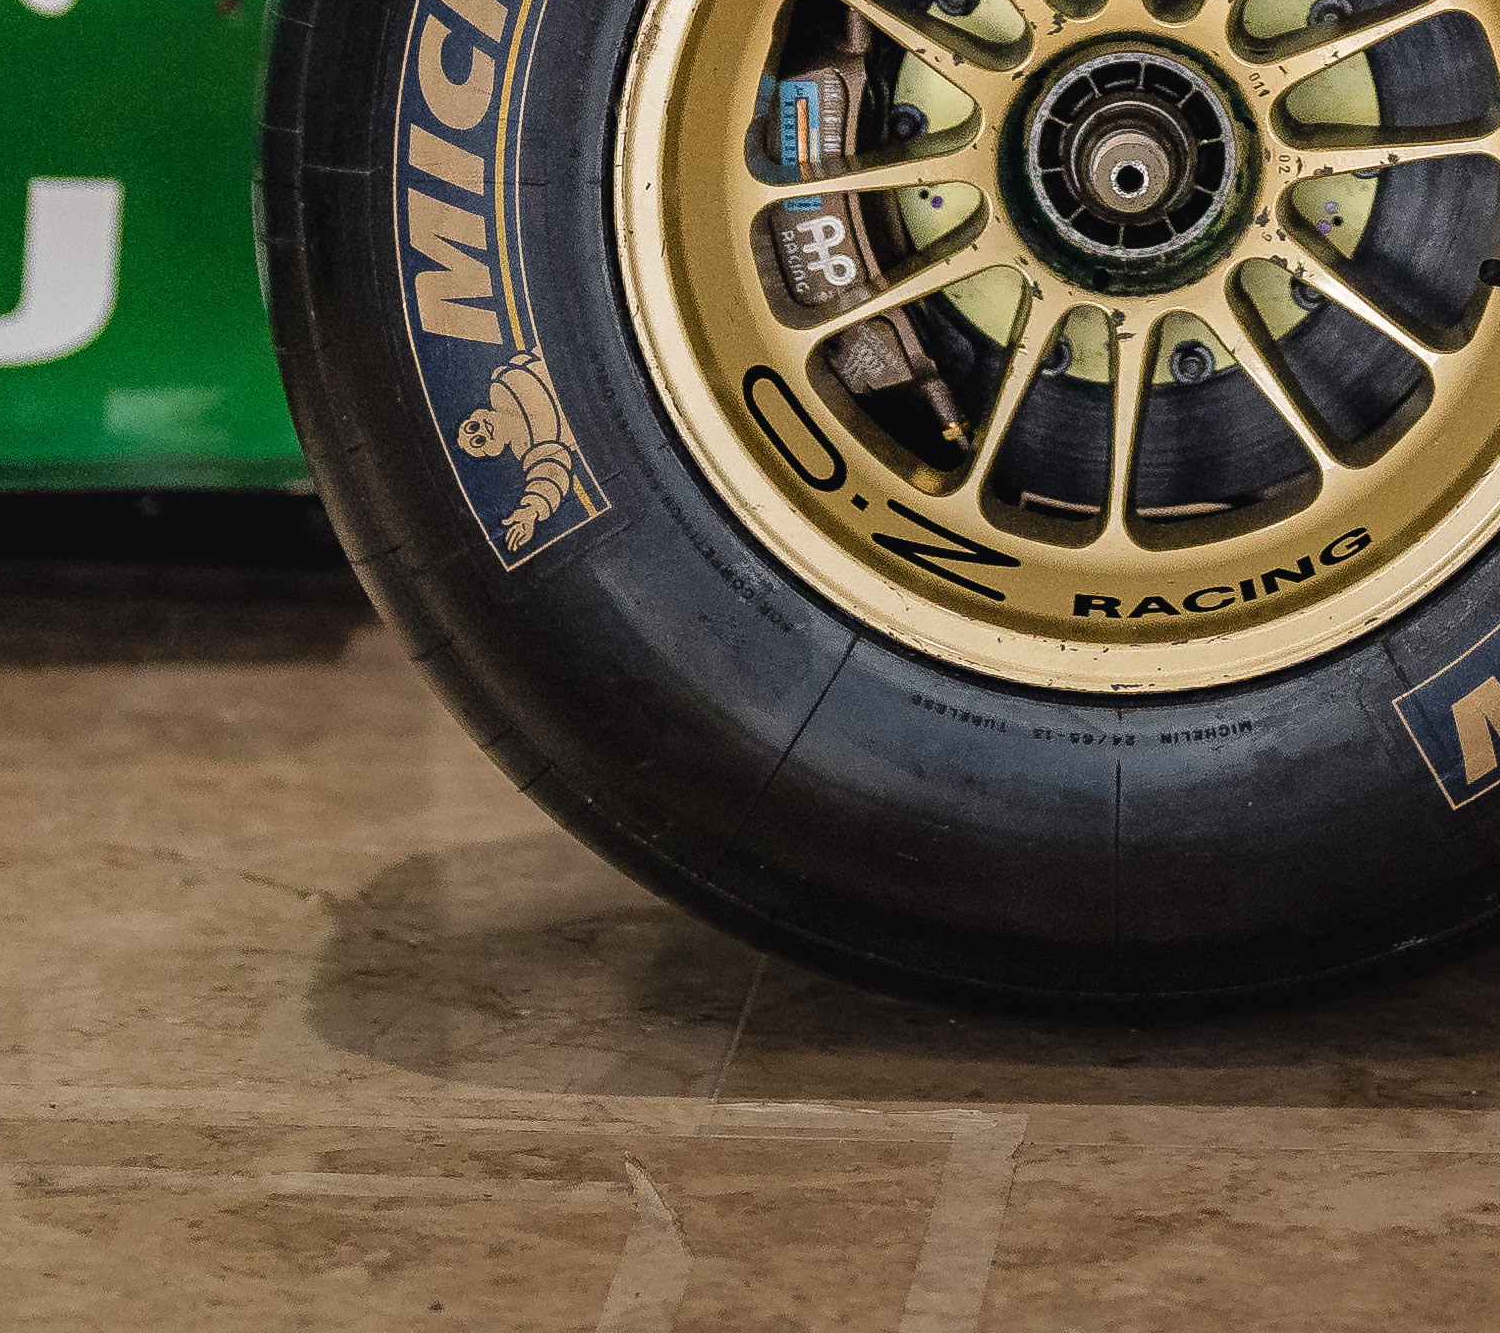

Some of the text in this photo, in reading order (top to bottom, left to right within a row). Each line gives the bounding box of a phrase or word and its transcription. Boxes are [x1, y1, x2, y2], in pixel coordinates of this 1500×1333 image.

[781, 230, 812, 294] RACING
[1072, 527, 1373, 619] RACING
[1160, 719, 1253, 746] MICHELIN
